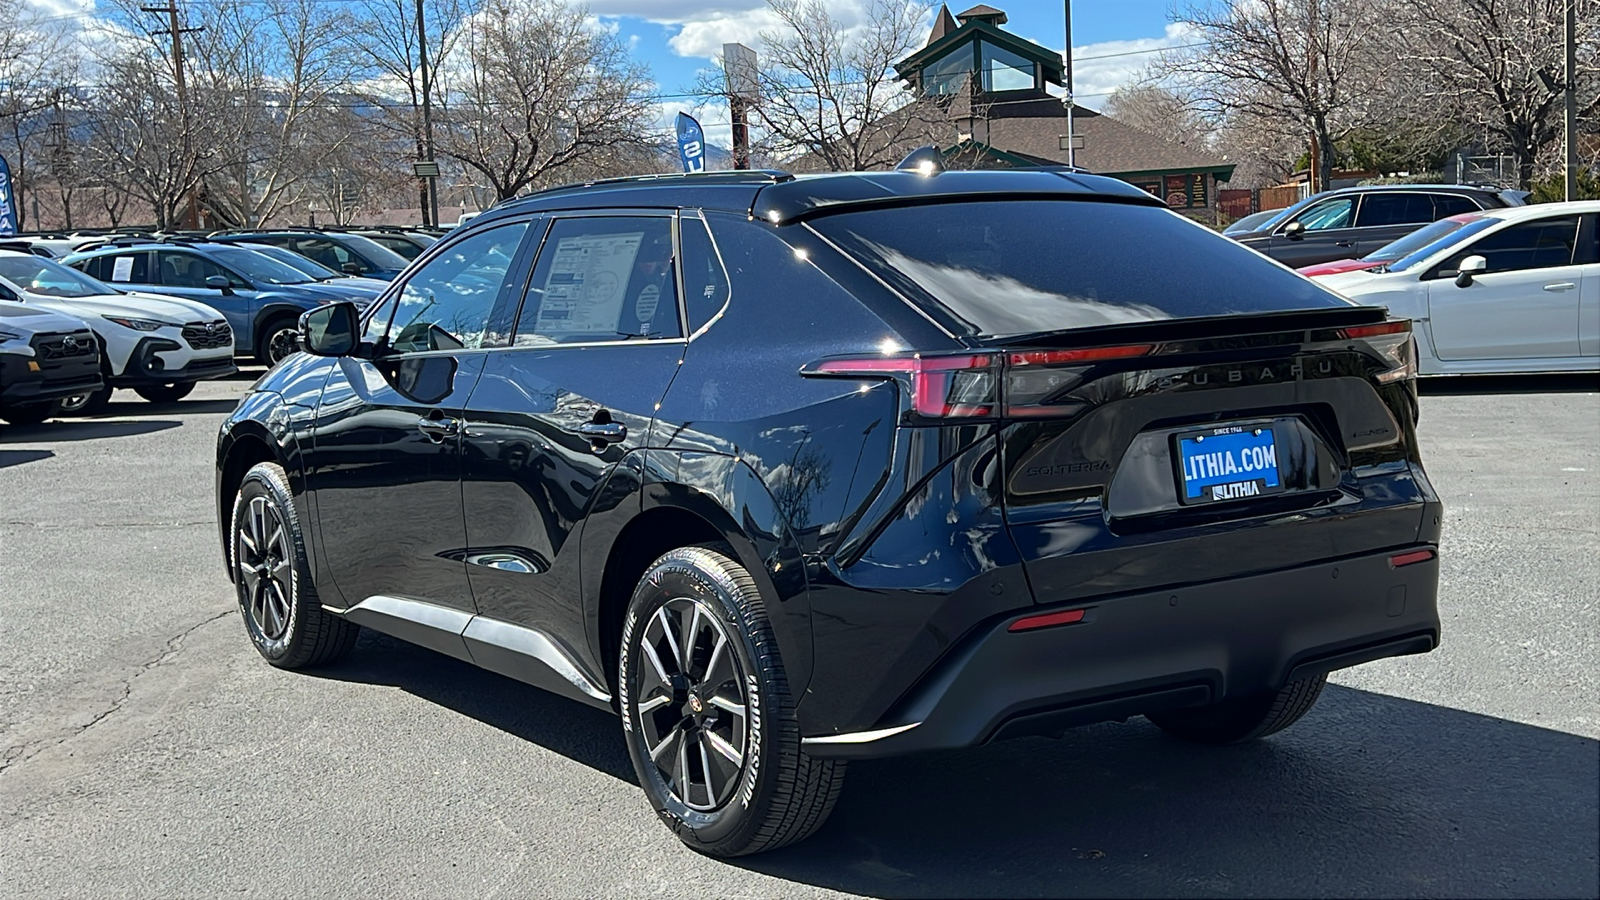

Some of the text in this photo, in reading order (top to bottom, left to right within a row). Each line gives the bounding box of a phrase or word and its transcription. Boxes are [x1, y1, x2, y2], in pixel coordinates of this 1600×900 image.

[1213, 427, 1230, 436] SINCE
[1027, 461, 1111, 477] SOLTERRA
[1182, 444, 1277, 481] LITHIA.COM
[1222, 481, 1260, 499] LITHIA
[741, 674, 762, 810] BRIDGESTONE
